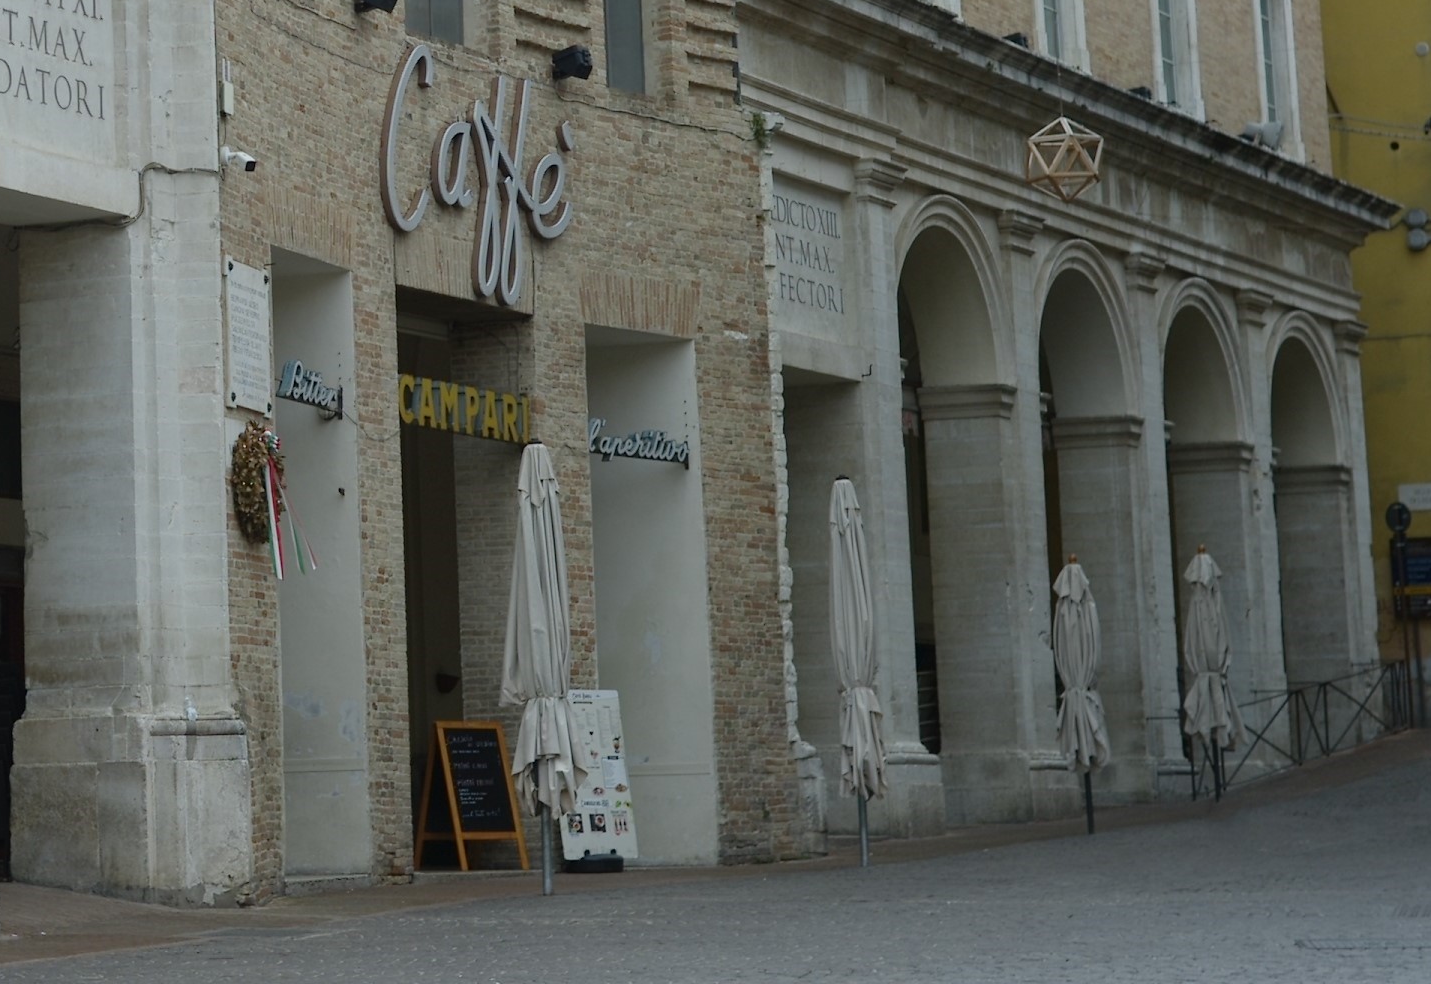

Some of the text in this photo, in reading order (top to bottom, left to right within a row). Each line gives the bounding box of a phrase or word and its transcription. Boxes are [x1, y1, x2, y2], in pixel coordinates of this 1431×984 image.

[283, 359, 338, 407] Bitter
[399, 373, 531, 444] CAMPARI
[588, 418, 689, 462] l'aperitivo
